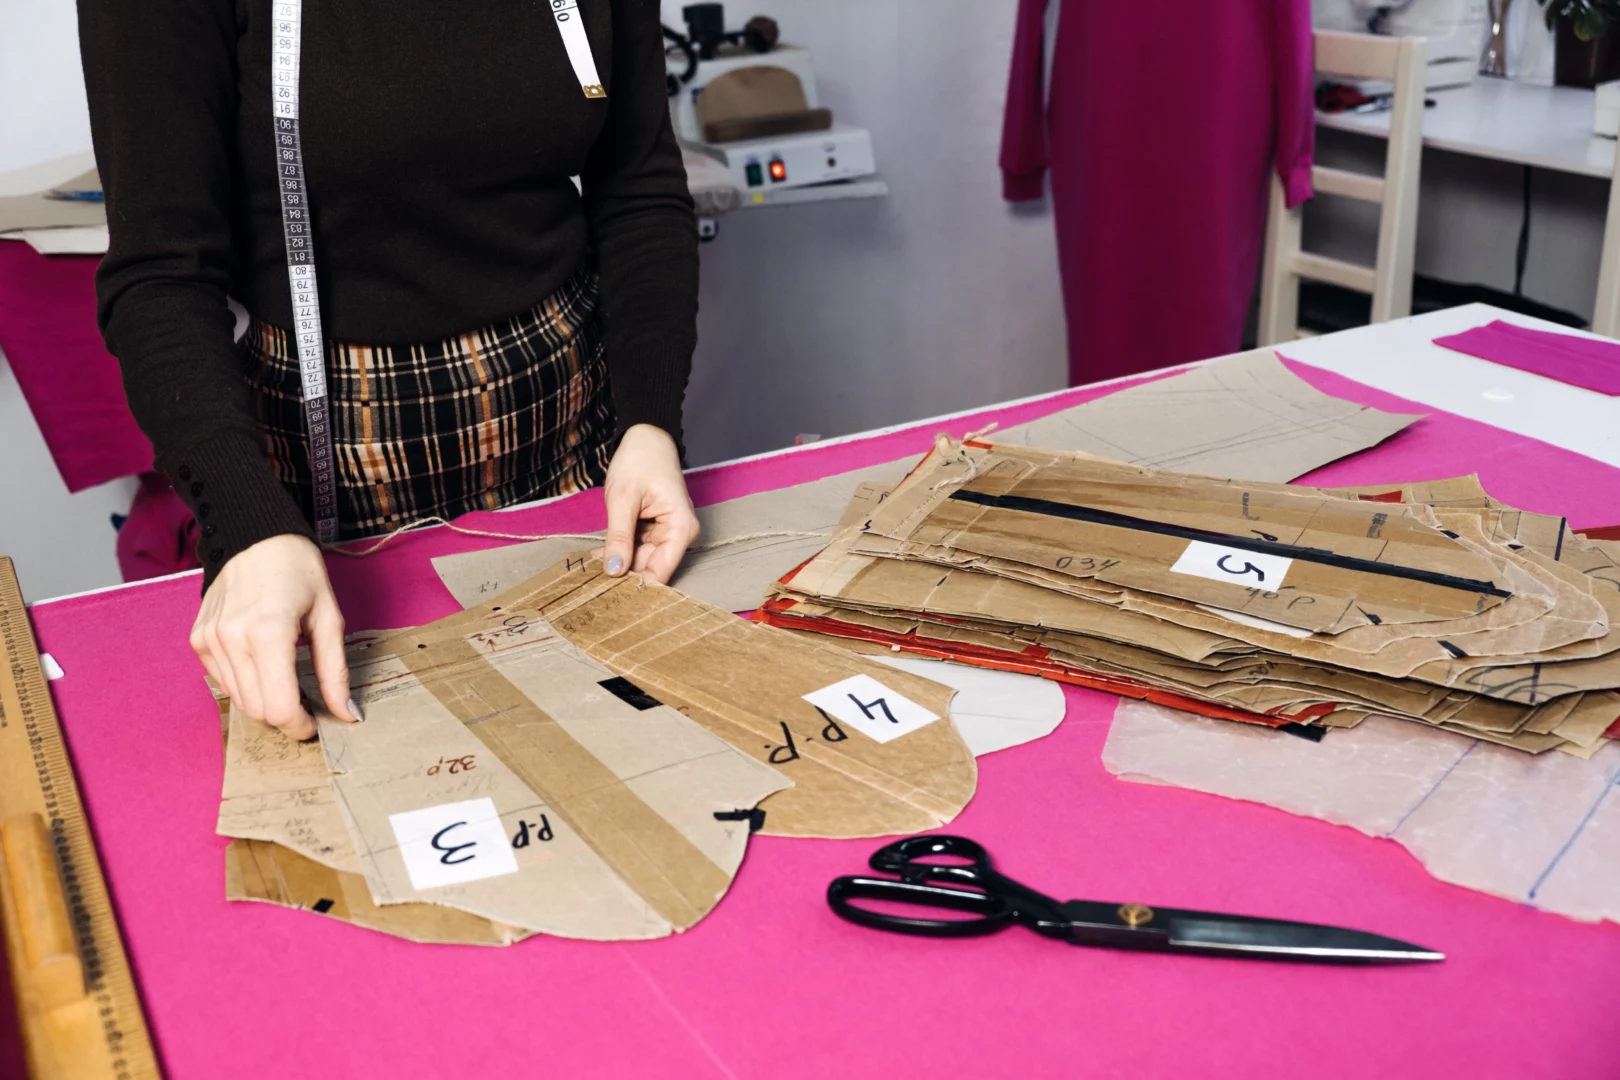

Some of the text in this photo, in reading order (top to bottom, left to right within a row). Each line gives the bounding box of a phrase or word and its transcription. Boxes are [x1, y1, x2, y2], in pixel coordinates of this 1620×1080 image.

[280, 7, 292, 16] 97
[280, 23, 291, 32] 96
[280, 39, 291, 49] 95
[280, 56, 290, 65] 94
[279, 72, 290, 81] 93
[279, 88, 290, 98] 92
[280, 104, 290, 113] 91
[280, 120, 291, 129] 90
[282, 135, 292, 144] 89
[283, 150, 294, 160] 88
[285, 166, 295, 174] 87
[286, 180, 297, 189] 86
[288, 195, 299, 204] 85
[290, 210, 300, 218] 84
[291, 224, 302, 232] 83
[292, 238, 304, 247] 82
[295, 252, 305, 261] 81
[295, 267, 306, 275] 80
[297, 281, 308, 289] 79
[299, 294, 310, 302] 78
[301, 308, 311, 316] 77
[302, 321, 313, 329] 76
[303, 335, 314, 343] 75
[305, 348, 315, 356] 74
[307, 361, 317, 369] 73
[308, 374, 318, 382] 72
[310, 387, 319, 395] 71
[311, 399, 321, 408] 70
[312, 412, 322, 421] 69
[314, 425, 324, 434] 68
[316, 437, 325, 446] 67
[317, 461, 327, 470] 65
[318, 474, 328, 482] 64
[1216, 554, 1265, 582] 5
[847, 693, 899, 724] 4
[432, 821, 477, 865] 3
